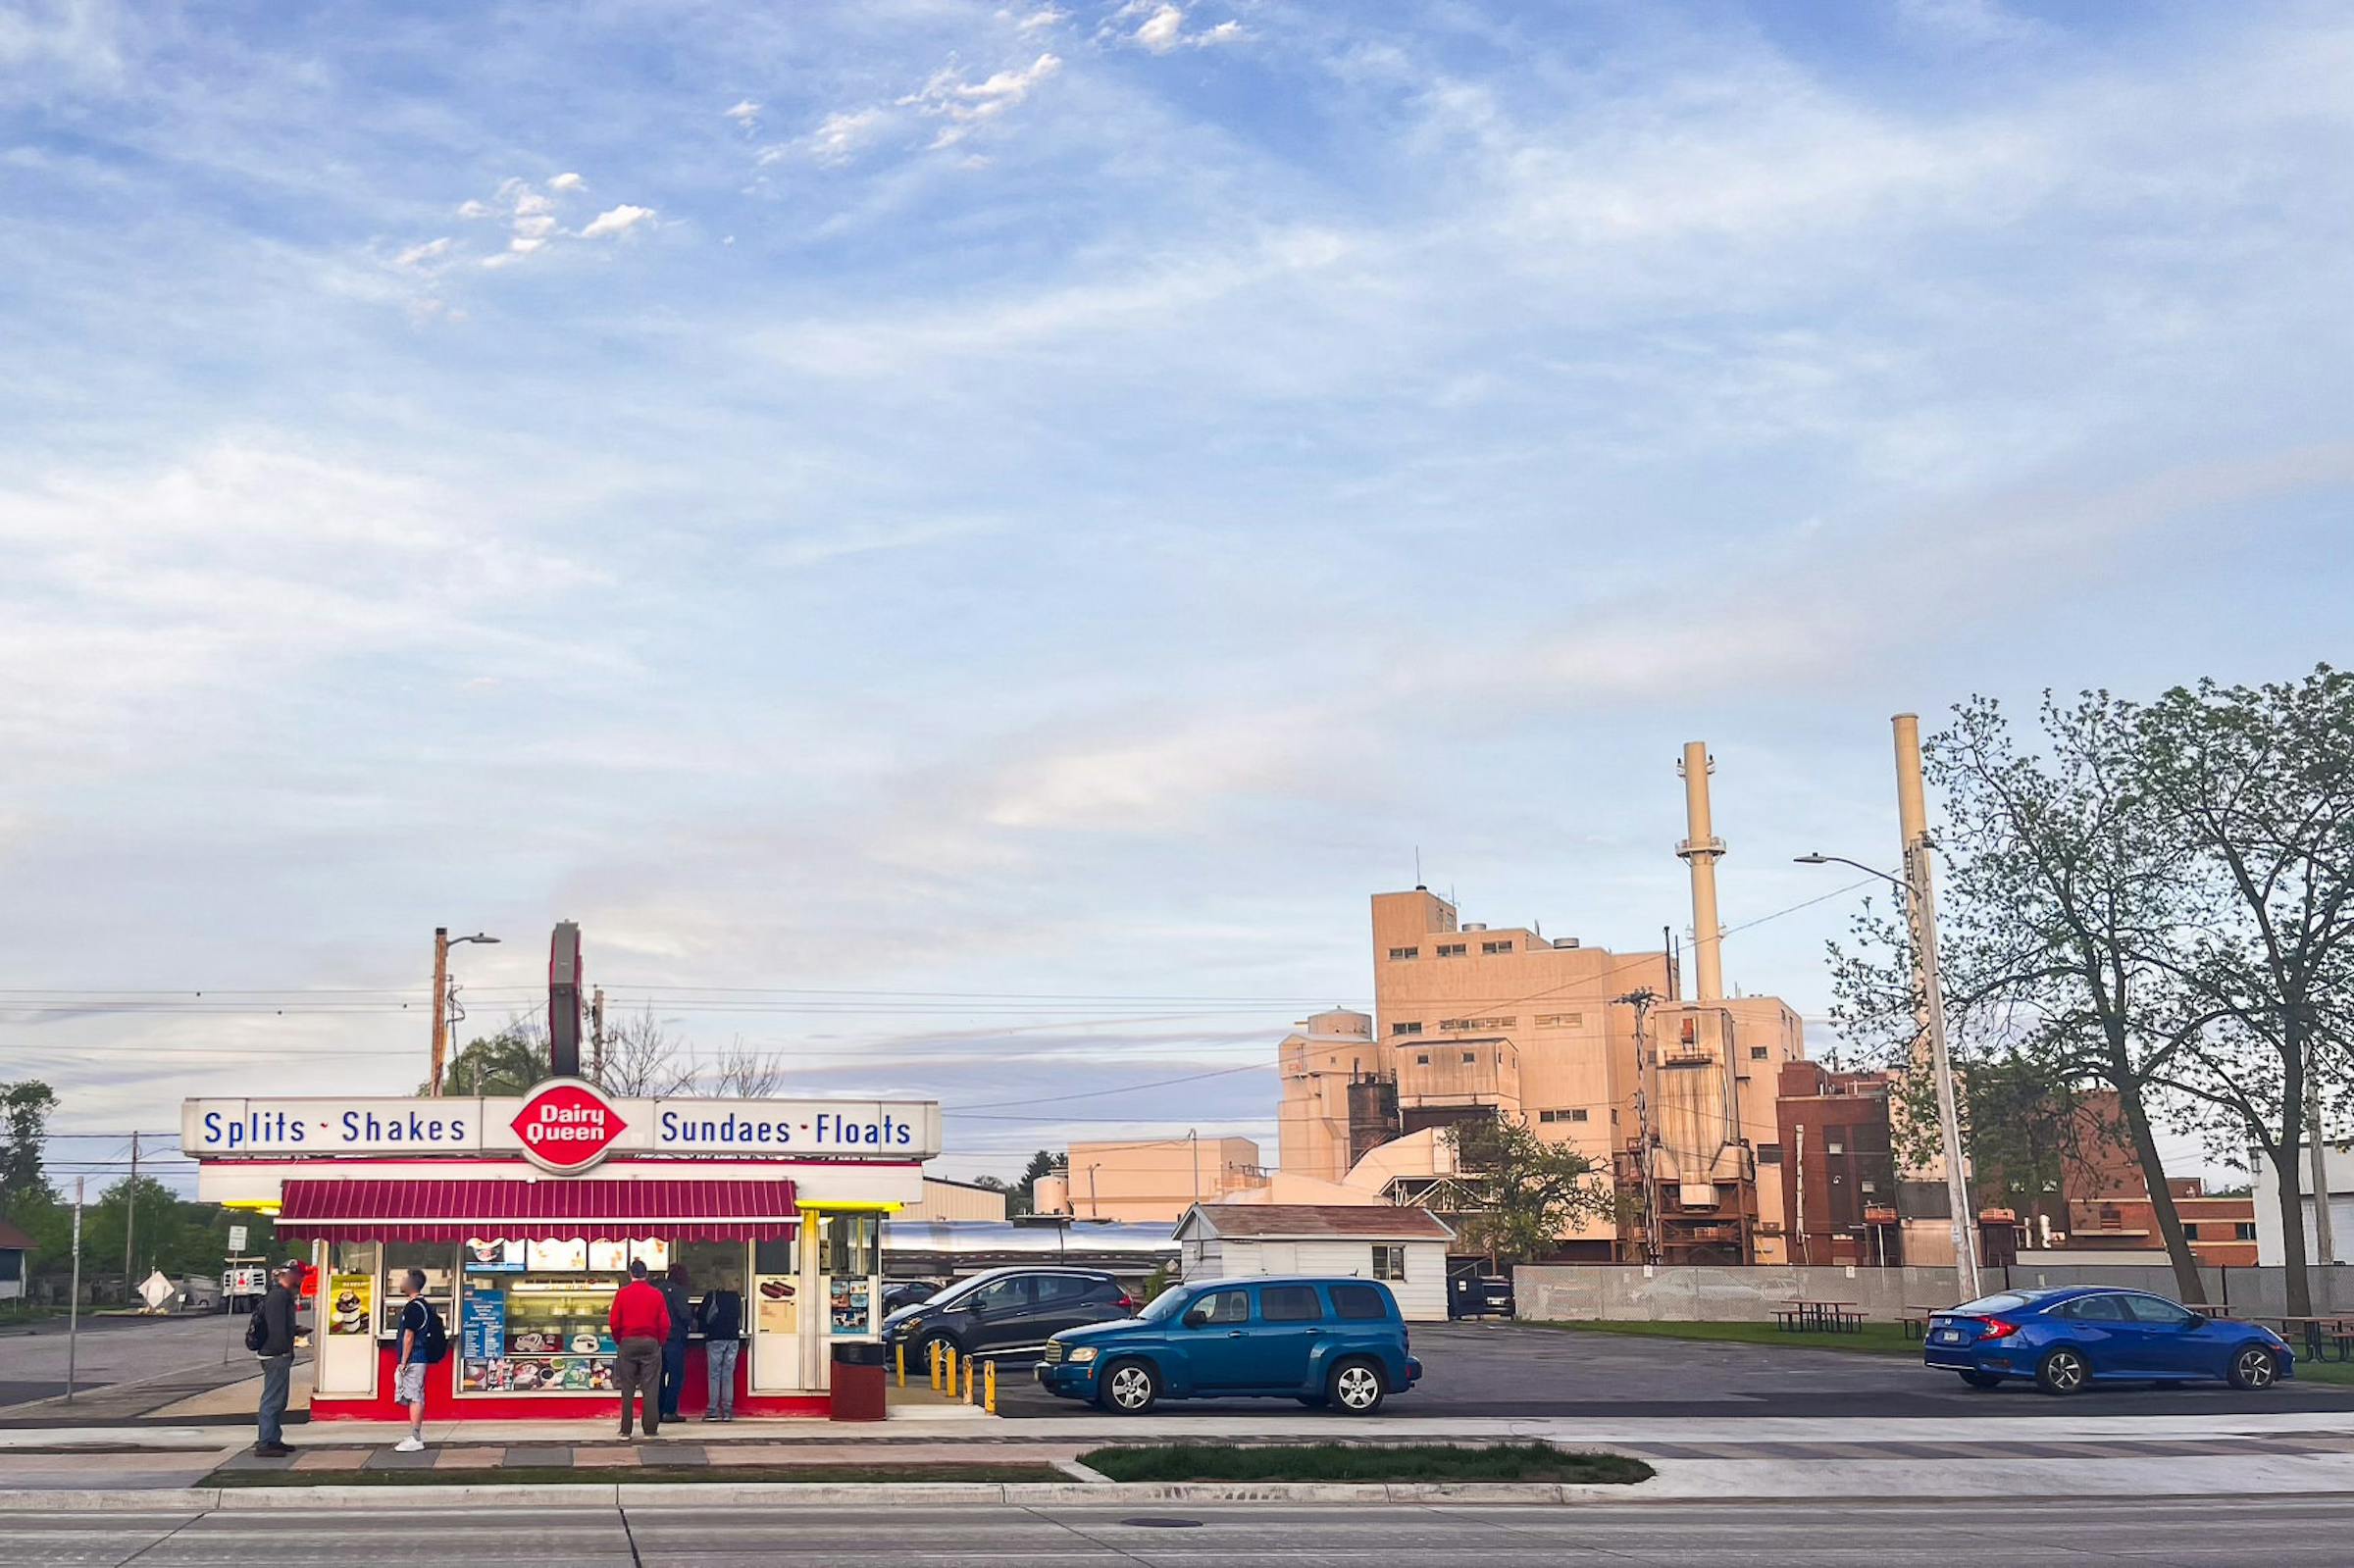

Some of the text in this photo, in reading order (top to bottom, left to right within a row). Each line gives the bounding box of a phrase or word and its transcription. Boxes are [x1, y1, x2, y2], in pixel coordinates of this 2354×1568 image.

[540, 1103, 605, 1126] Dairy
[661, 1111, 910, 1144] Sundaes Floats
[204, 1111, 465, 1148] Splits Shakes
[527, 1123, 605, 1144] Queen
